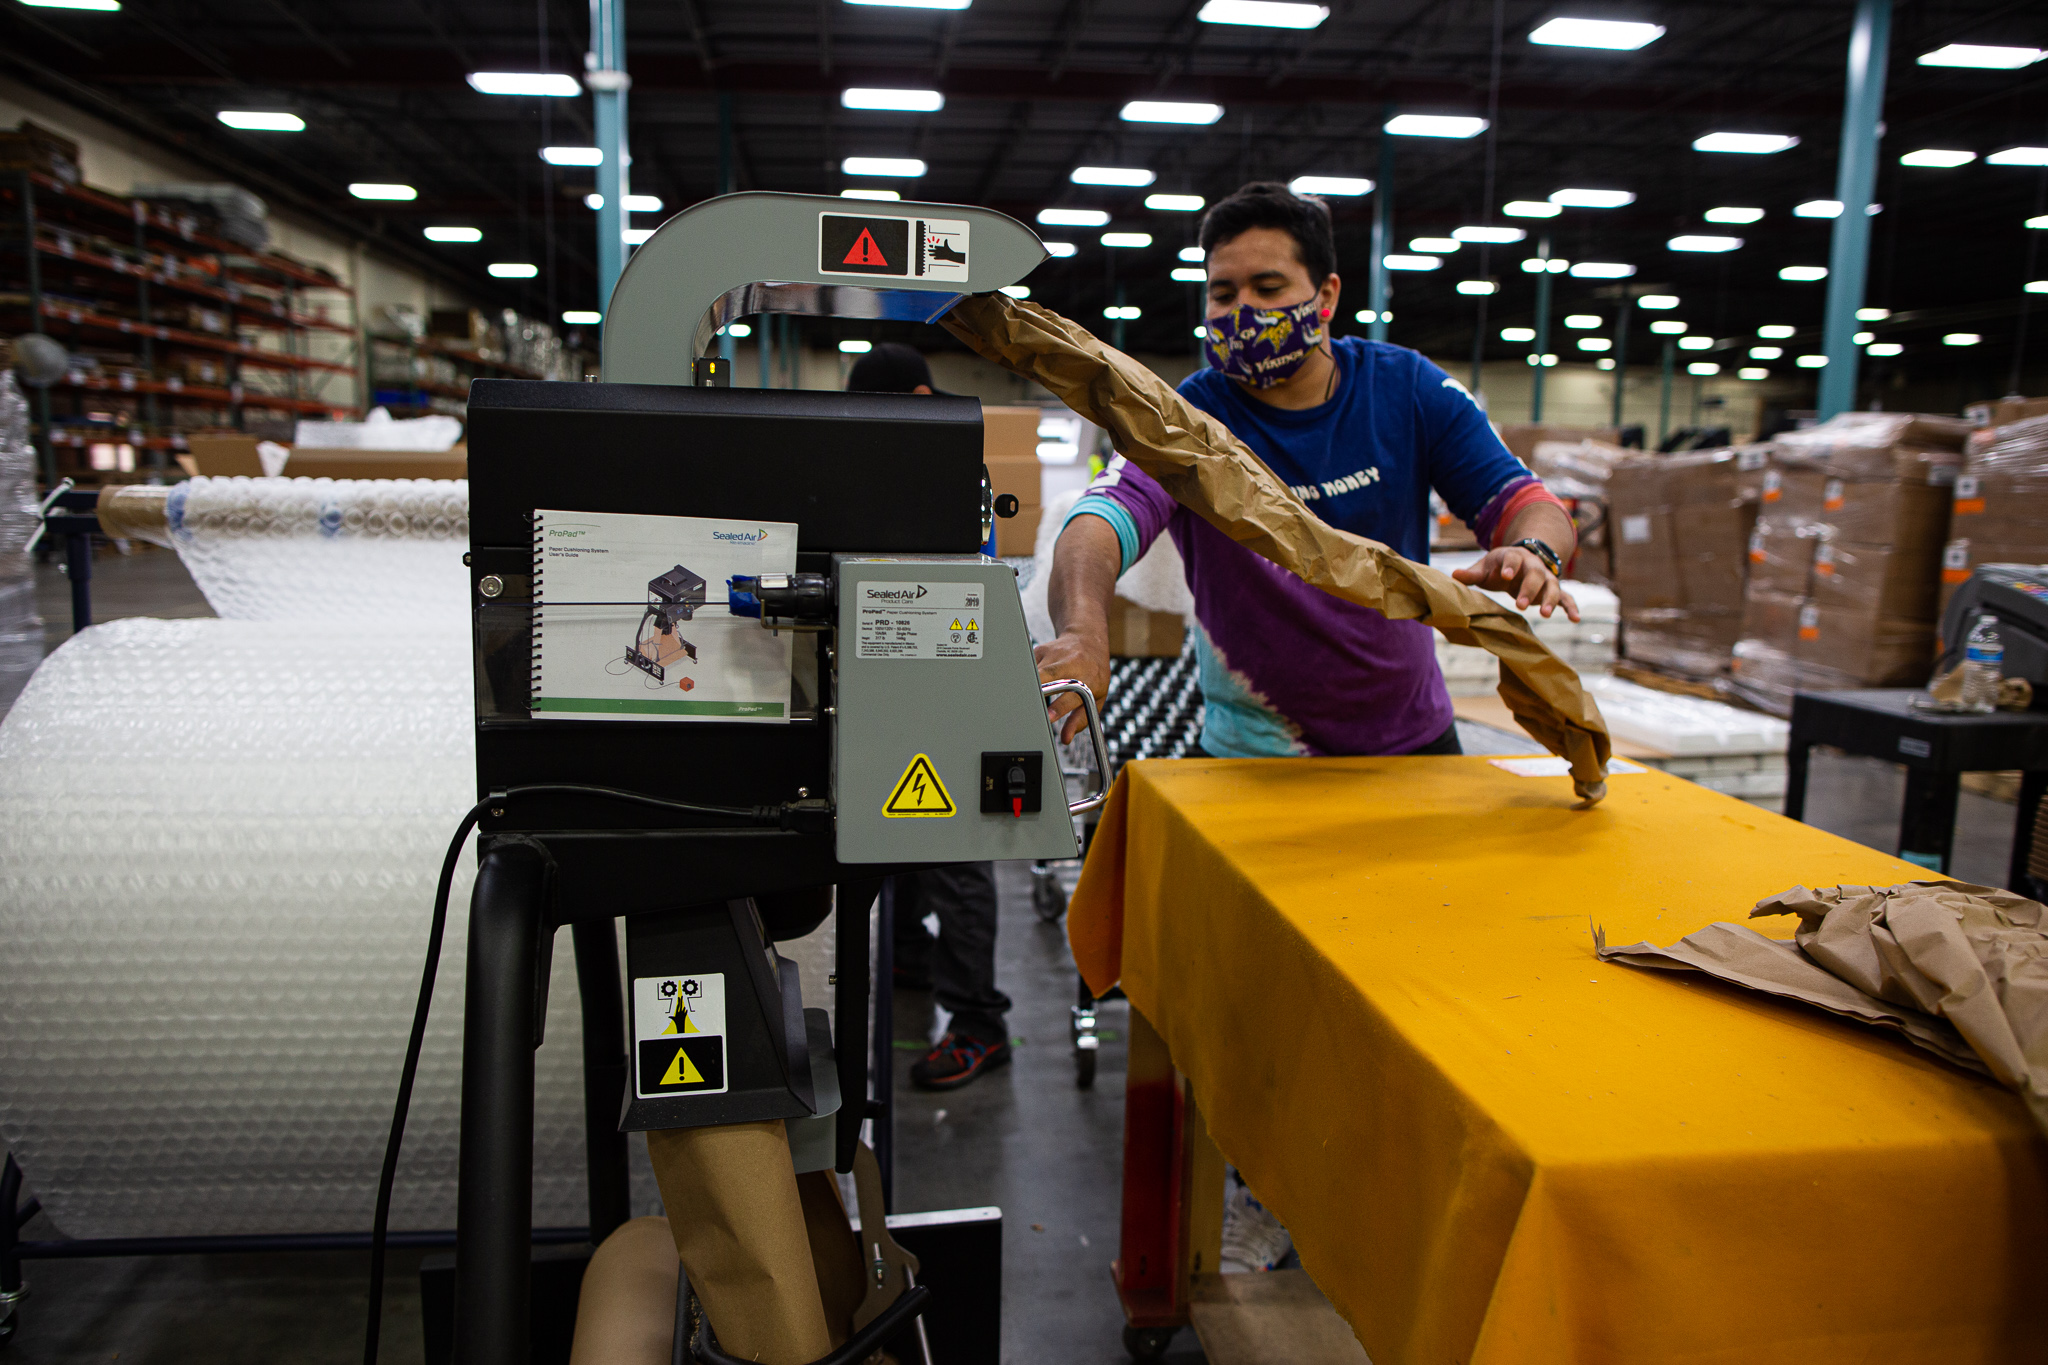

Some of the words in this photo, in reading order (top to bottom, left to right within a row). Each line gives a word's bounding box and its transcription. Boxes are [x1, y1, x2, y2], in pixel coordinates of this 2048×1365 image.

[1320, 466, 1380, 497] MONEY
[712, 531, 743, 541] Sealed
[867, 589, 900, 599] Sealed
[901, 590, 915, 599] Air
